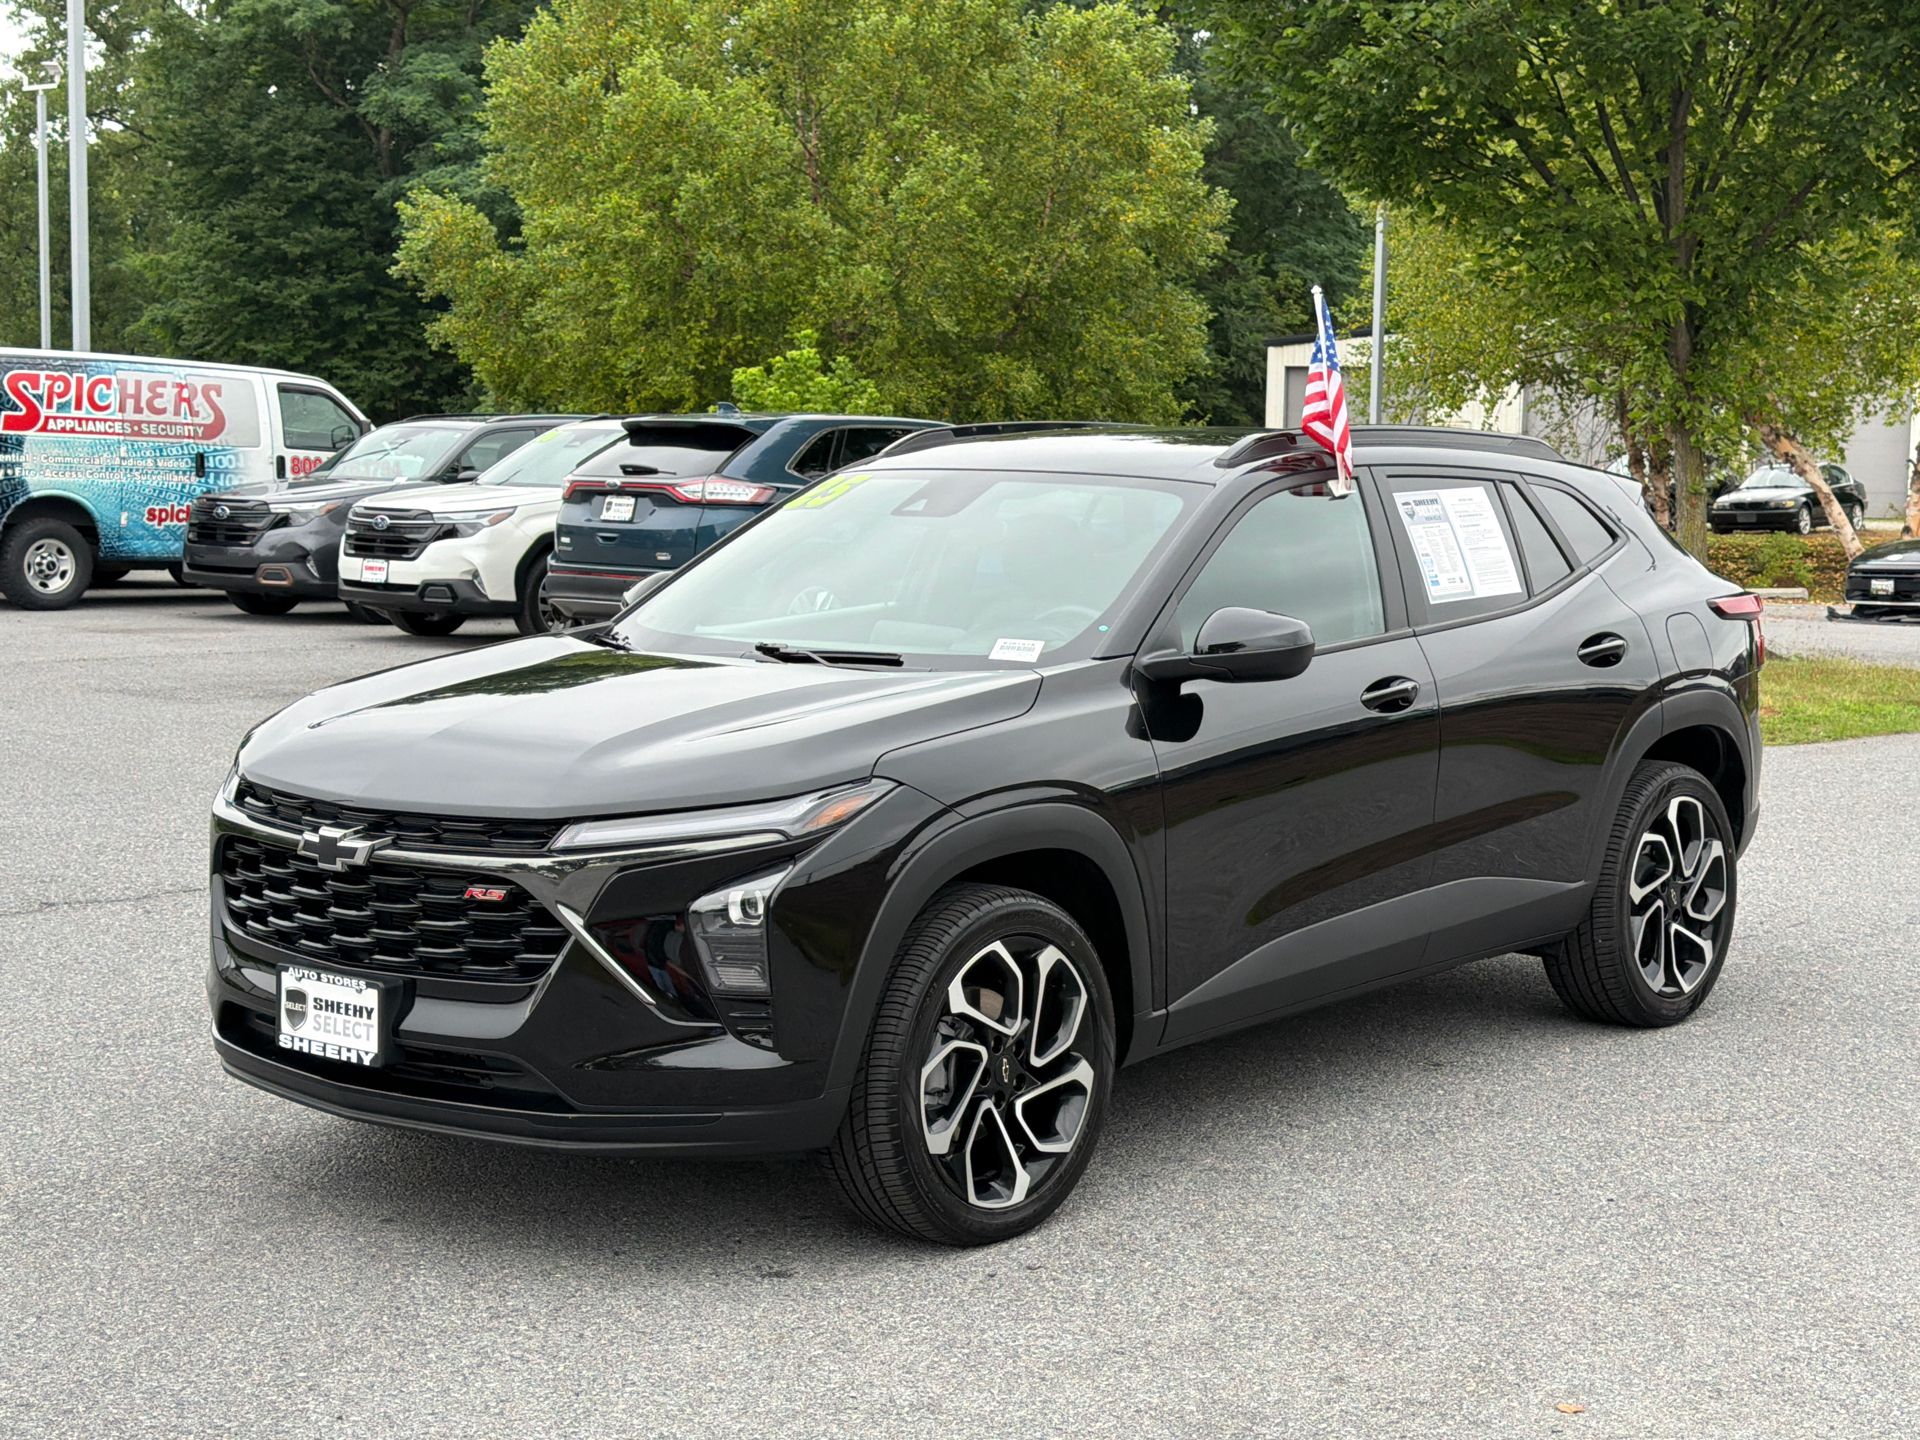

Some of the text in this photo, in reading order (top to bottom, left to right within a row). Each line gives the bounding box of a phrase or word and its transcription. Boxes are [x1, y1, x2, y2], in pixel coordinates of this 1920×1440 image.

[1, 371, 227, 438] SPICHERS
[47, 418, 204, 436] APPLIANCES SECURITY
[41, 454, 103, 465] Commercial
[115, 457, 143, 466] Audio
[157, 458, 186, 468] Video
[15, 467, 37, 477] Fire
[45, 468, 83, 478] Access
[86, 469, 124, 479] Control
[135, 471, 197, 482] Surveillance
[782, 474, 873, 509] 25
[1413, 497, 1439, 507] SHEEHY
[465, 887, 507, 901] RS
[288, 967, 367, 990] AUTO STORES
[285, 1001, 307, 1012] SELECT
[313, 997, 375, 1020] SHEEHY
[312, 1014, 375, 1041] SELECT
[278, 1034, 376, 1066] SHEEHY
